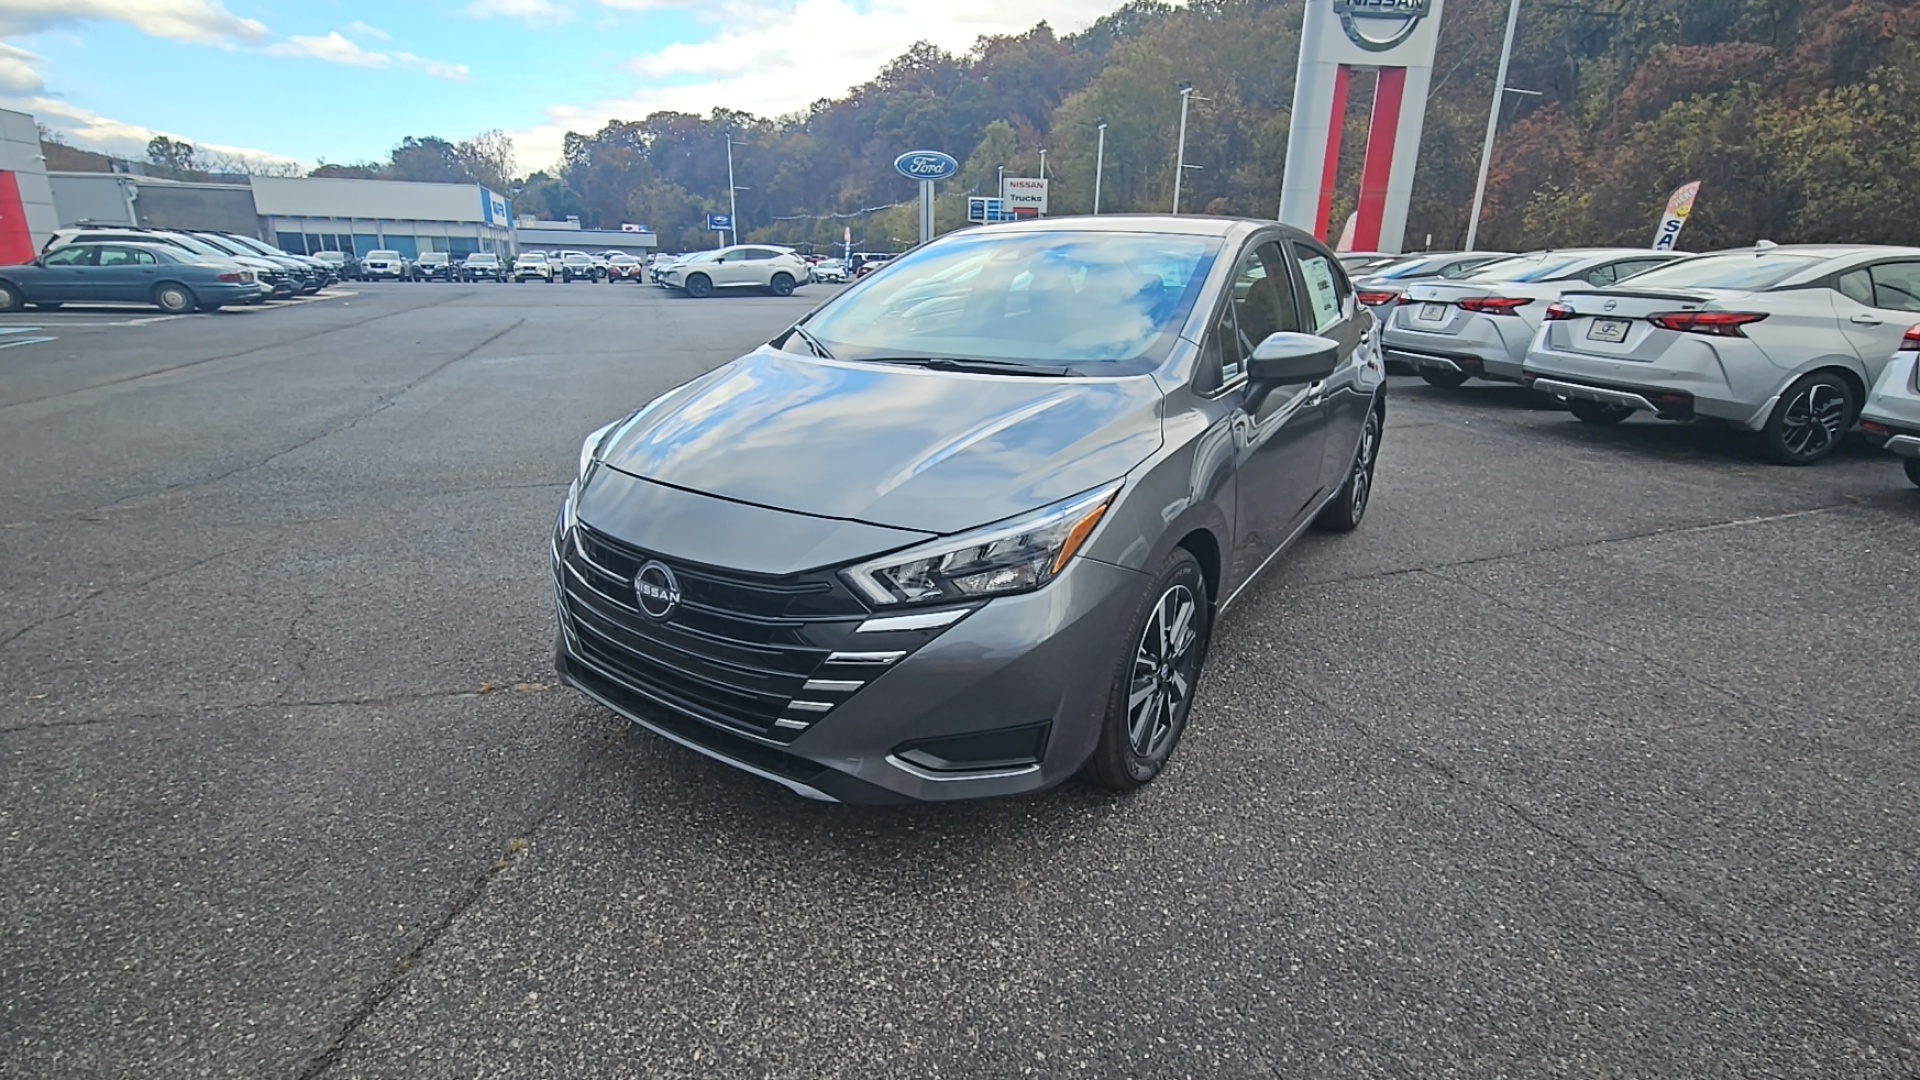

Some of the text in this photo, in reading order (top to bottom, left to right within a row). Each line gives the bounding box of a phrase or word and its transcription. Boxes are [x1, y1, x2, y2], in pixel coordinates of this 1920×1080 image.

[910, 156, 945, 173] Ford
[1009, 181, 1043, 189] NISSAN
[1010, 194, 1042, 202] Trucks
[1656, 220, 1681, 250] SA
[634, 577, 680, 603] NISSAN
